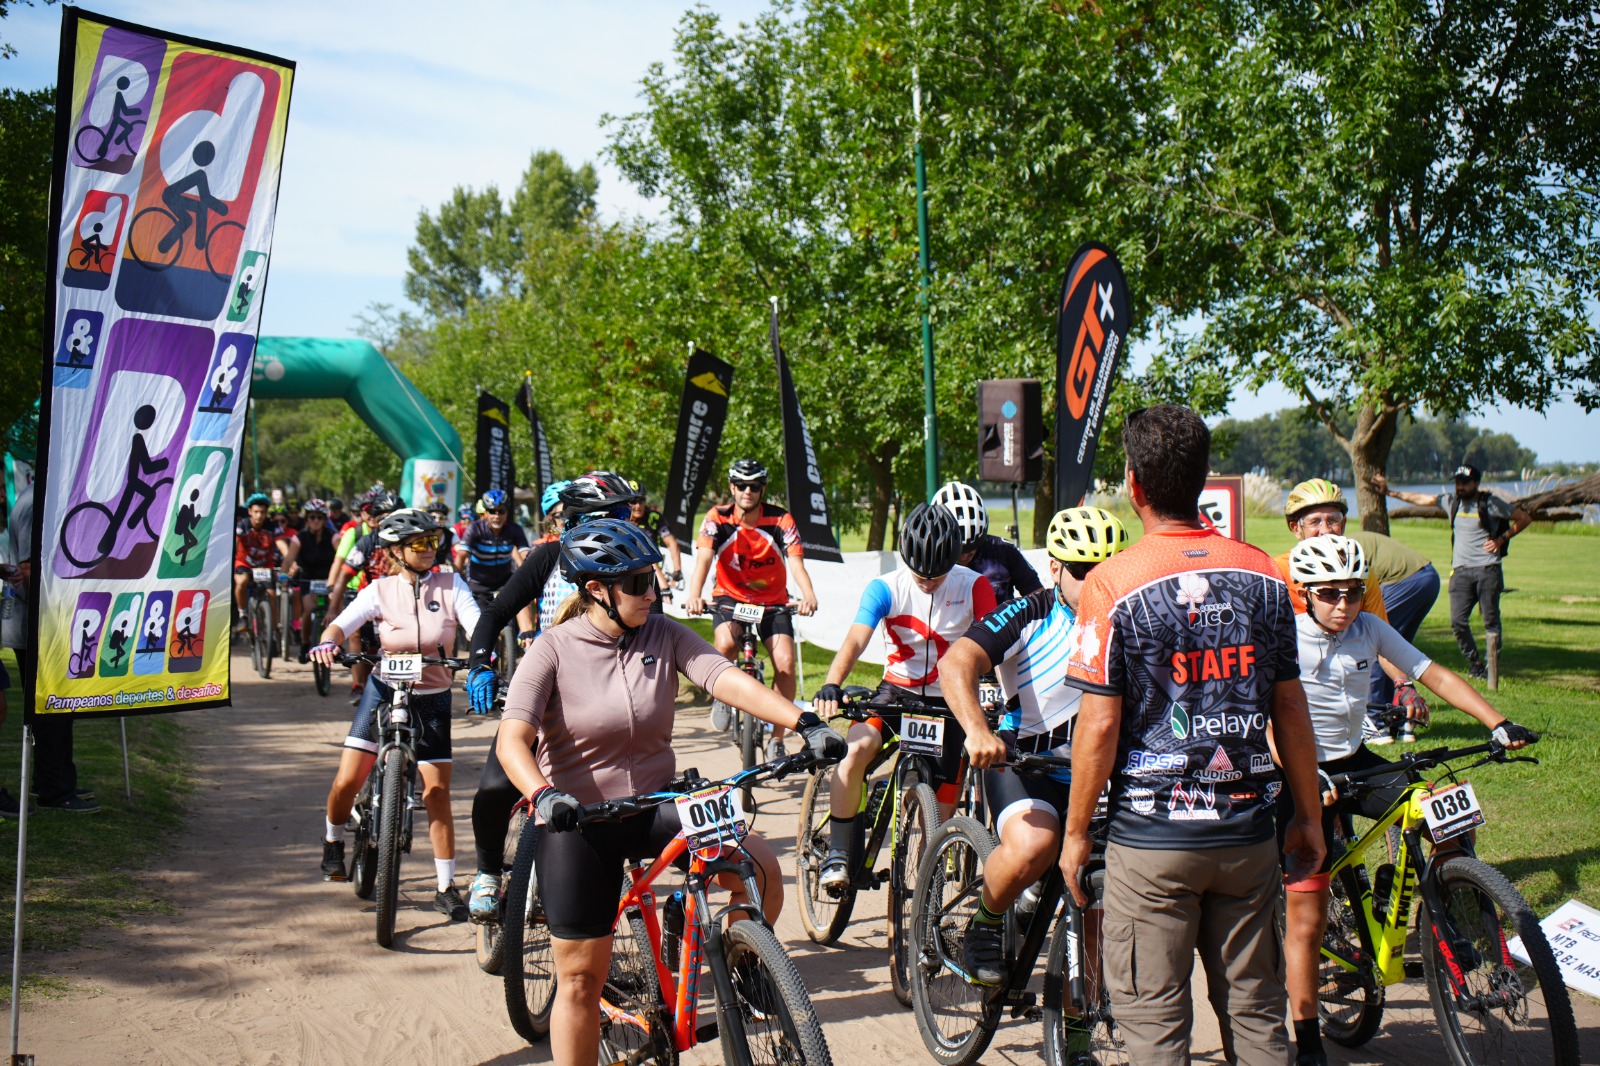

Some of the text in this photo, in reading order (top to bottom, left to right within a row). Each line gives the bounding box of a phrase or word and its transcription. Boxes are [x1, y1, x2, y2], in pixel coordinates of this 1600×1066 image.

[1091, 336, 1120, 427] ENTRENAMIENTO
[1077, 419, 1094, 465] CENTRO
[597, 564, 629, 574] LAZER
[739, 606, 760, 617] 036
[1200, 602, 1231, 611] GENERAL
[1189, 608, 1235, 629] PICO
[389, 660, 413, 671] 012
[1171, 645, 1255, 684] STAFF
[45, 694, 113, 711] Pampeanos
[115, 688, 165, 706] deportes
[166, 686, 175, 700] &
[908, 721, 937, 741] 044
[1192, 712, 1264, 739] Pelayo
[1192, 769, 1242, 781] AUDISIO
[1431, 789, 1471, 821] 038
[1394, 854, 1416, 930] TWITTE
[1550, 933, 1578, 949] MTB
